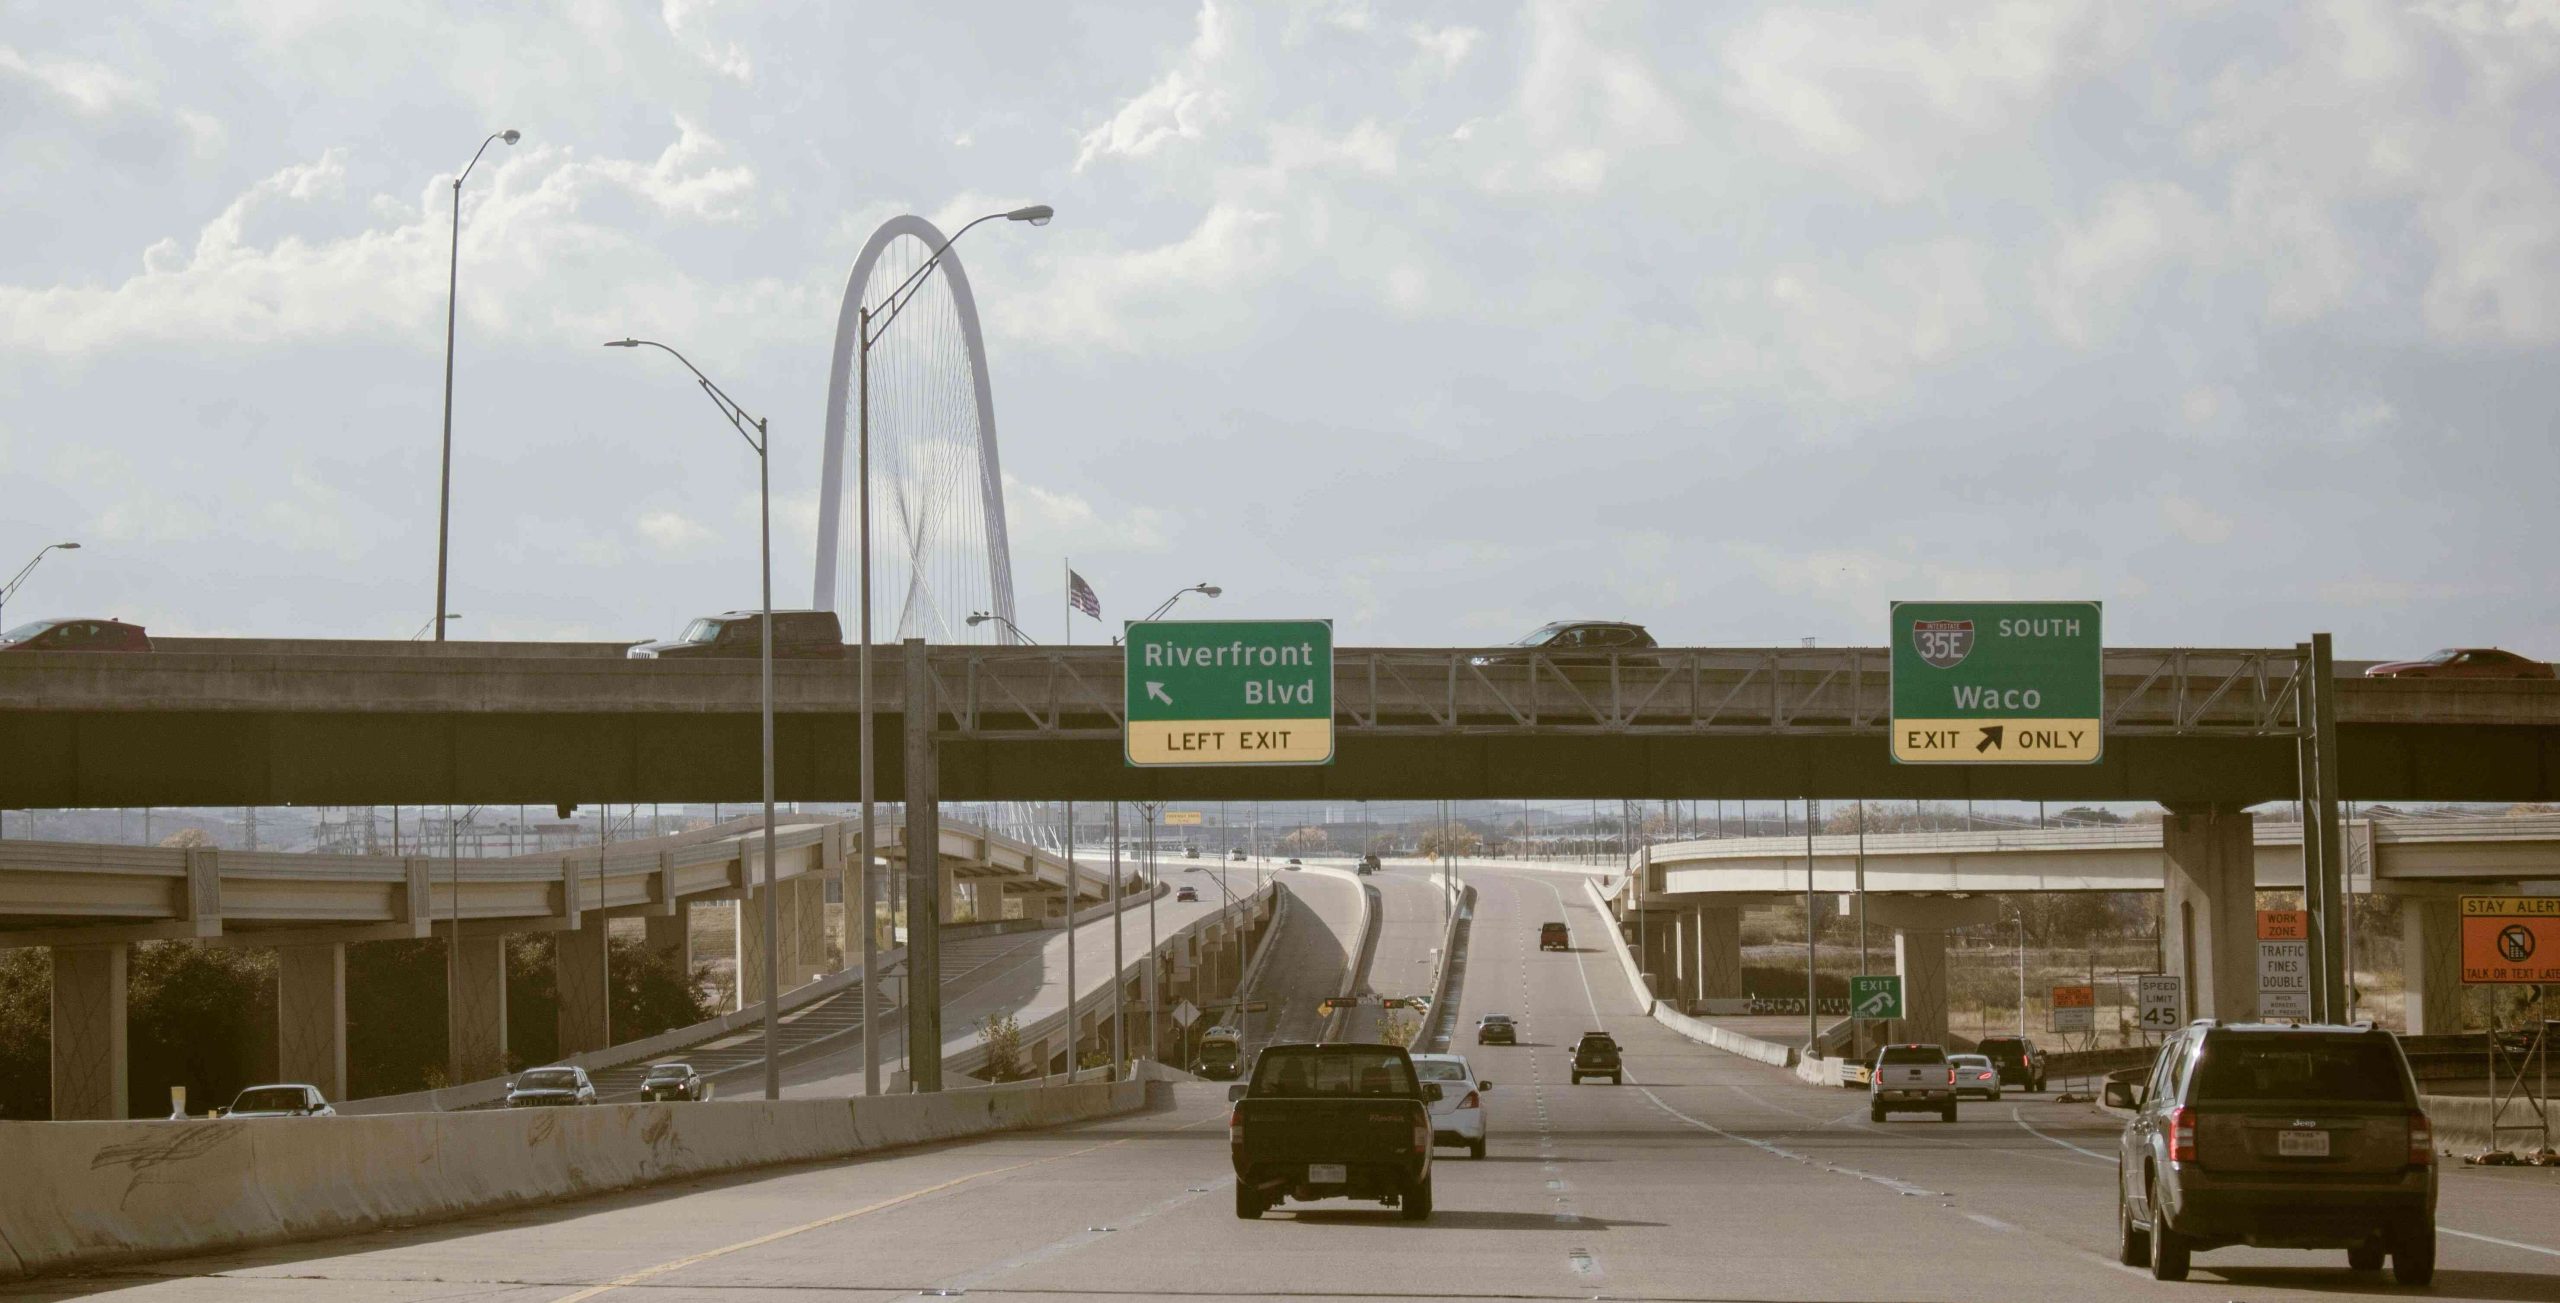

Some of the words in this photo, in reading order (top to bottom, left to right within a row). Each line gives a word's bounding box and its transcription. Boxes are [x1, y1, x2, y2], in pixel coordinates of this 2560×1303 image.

[1999, 619, 2080, 637] SOUTH
[1921, 632, 1963, 659] 35E
[1145, 641, 1313, 667] Riverfront
[1245, 679, 1314, 705] Blvd
[1953, 686, 2041, 710] Waco
[1167, 732, 1225, 751] LEFT
[1240, 731, 1292, 749] EXIT
[1908, 731, 1960, 749] EXIT
[2018, 731, 2084, 749] ONLY
[2468, 900, 2505, 913] STAY
[2268, 914, 2297, 923] WORK
[2269, 927, 2296, 936] ZONE
[2261, 945, 2304, 957] TRAFFIC
[2268, 961, 2298, 973] FINES
[2466, 968, 2489, 979] TALK
[2494, 968, 2507, 979] OR
[2512, 968, 2534, 979] TEXT
[2539, 968, 2560, 979] LATE
[1860, 981, 1892, 991] EXIT
[2143, 982, 2177, 990] SPEED
[2262, 976, 2303, 988] DOUBLE
[2146, 995, 2174, 1003] LIMIT
[2144, 1007, 2177, 1025] 45
